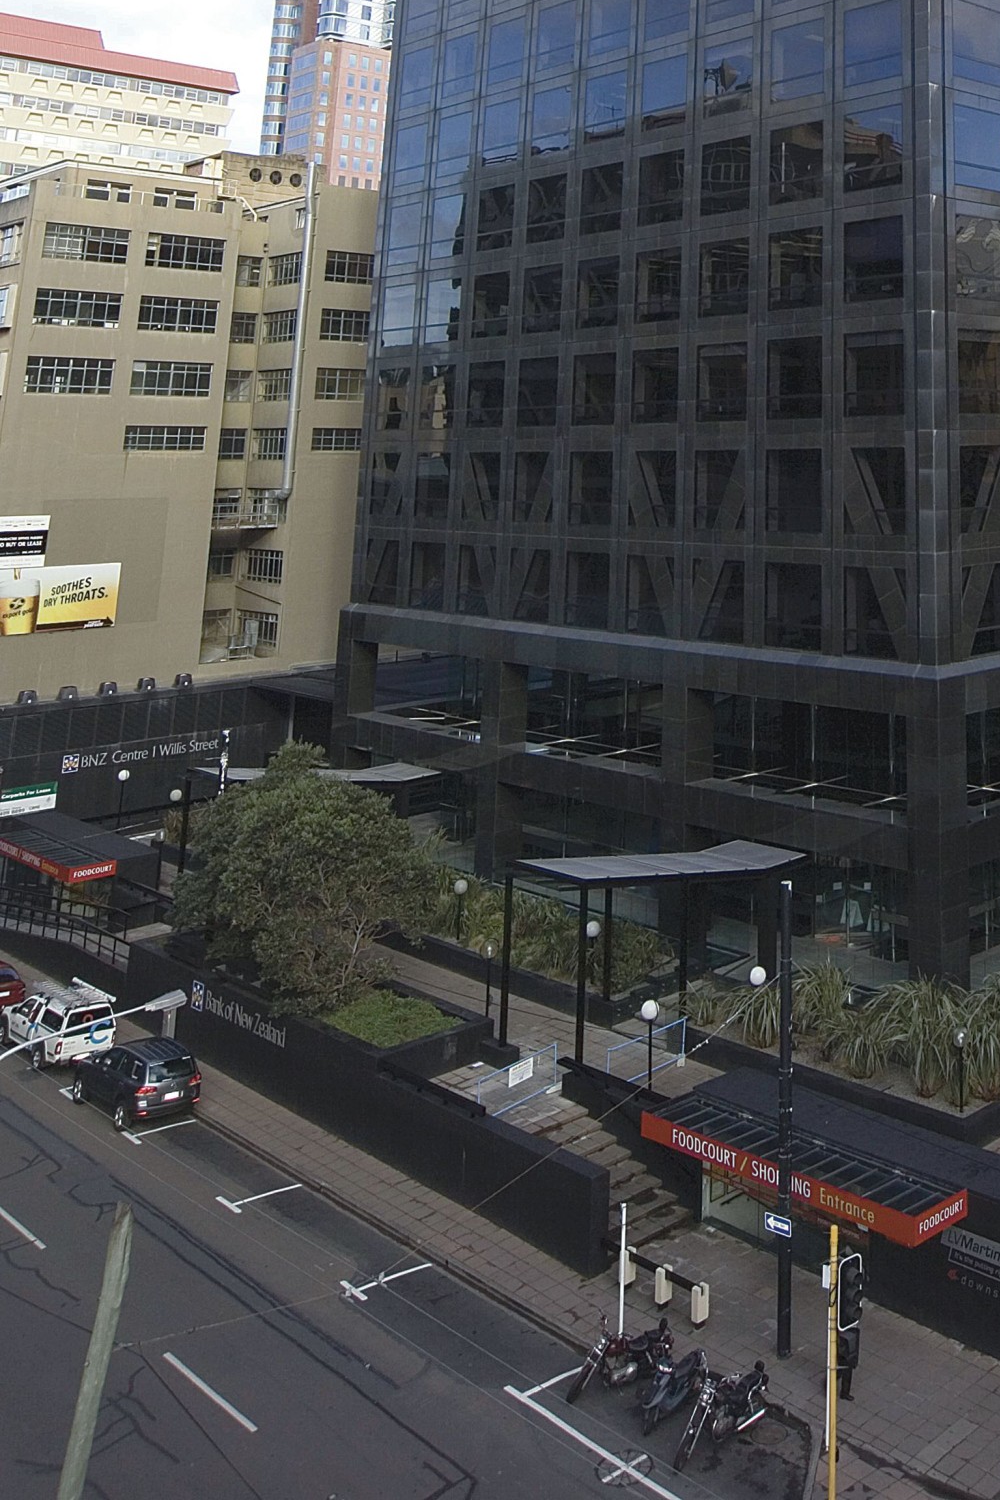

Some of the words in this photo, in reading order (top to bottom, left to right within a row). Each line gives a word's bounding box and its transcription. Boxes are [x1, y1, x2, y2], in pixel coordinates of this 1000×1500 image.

[43, 597, 57, 608] DRY
[60, 586, 108, 605] THROATS.
[51, 577, 92, 596] SOOTHES
[81, 753, 108, 768] BNZ
[112, 749, 149, 764] Centre
[159, 742, 187, 757] Willis
[189, 739, 219, 753] Street
[73, 864, 113, 879] FOODCOURT
[205, 989, 225, 1018] Bank
[224, 1001, 235, 1022] of
[234, 1003, 254, 1031] New
[253, 1013, 286, 1048] Zealand
[672, 1128, 737, 1168] FOODCOURT
[751, 1160, 811, 1198] SHOING
[819, 1187, 875, 1224] Entrance
[919, 1198, 964, 1234] FOODCOURT
